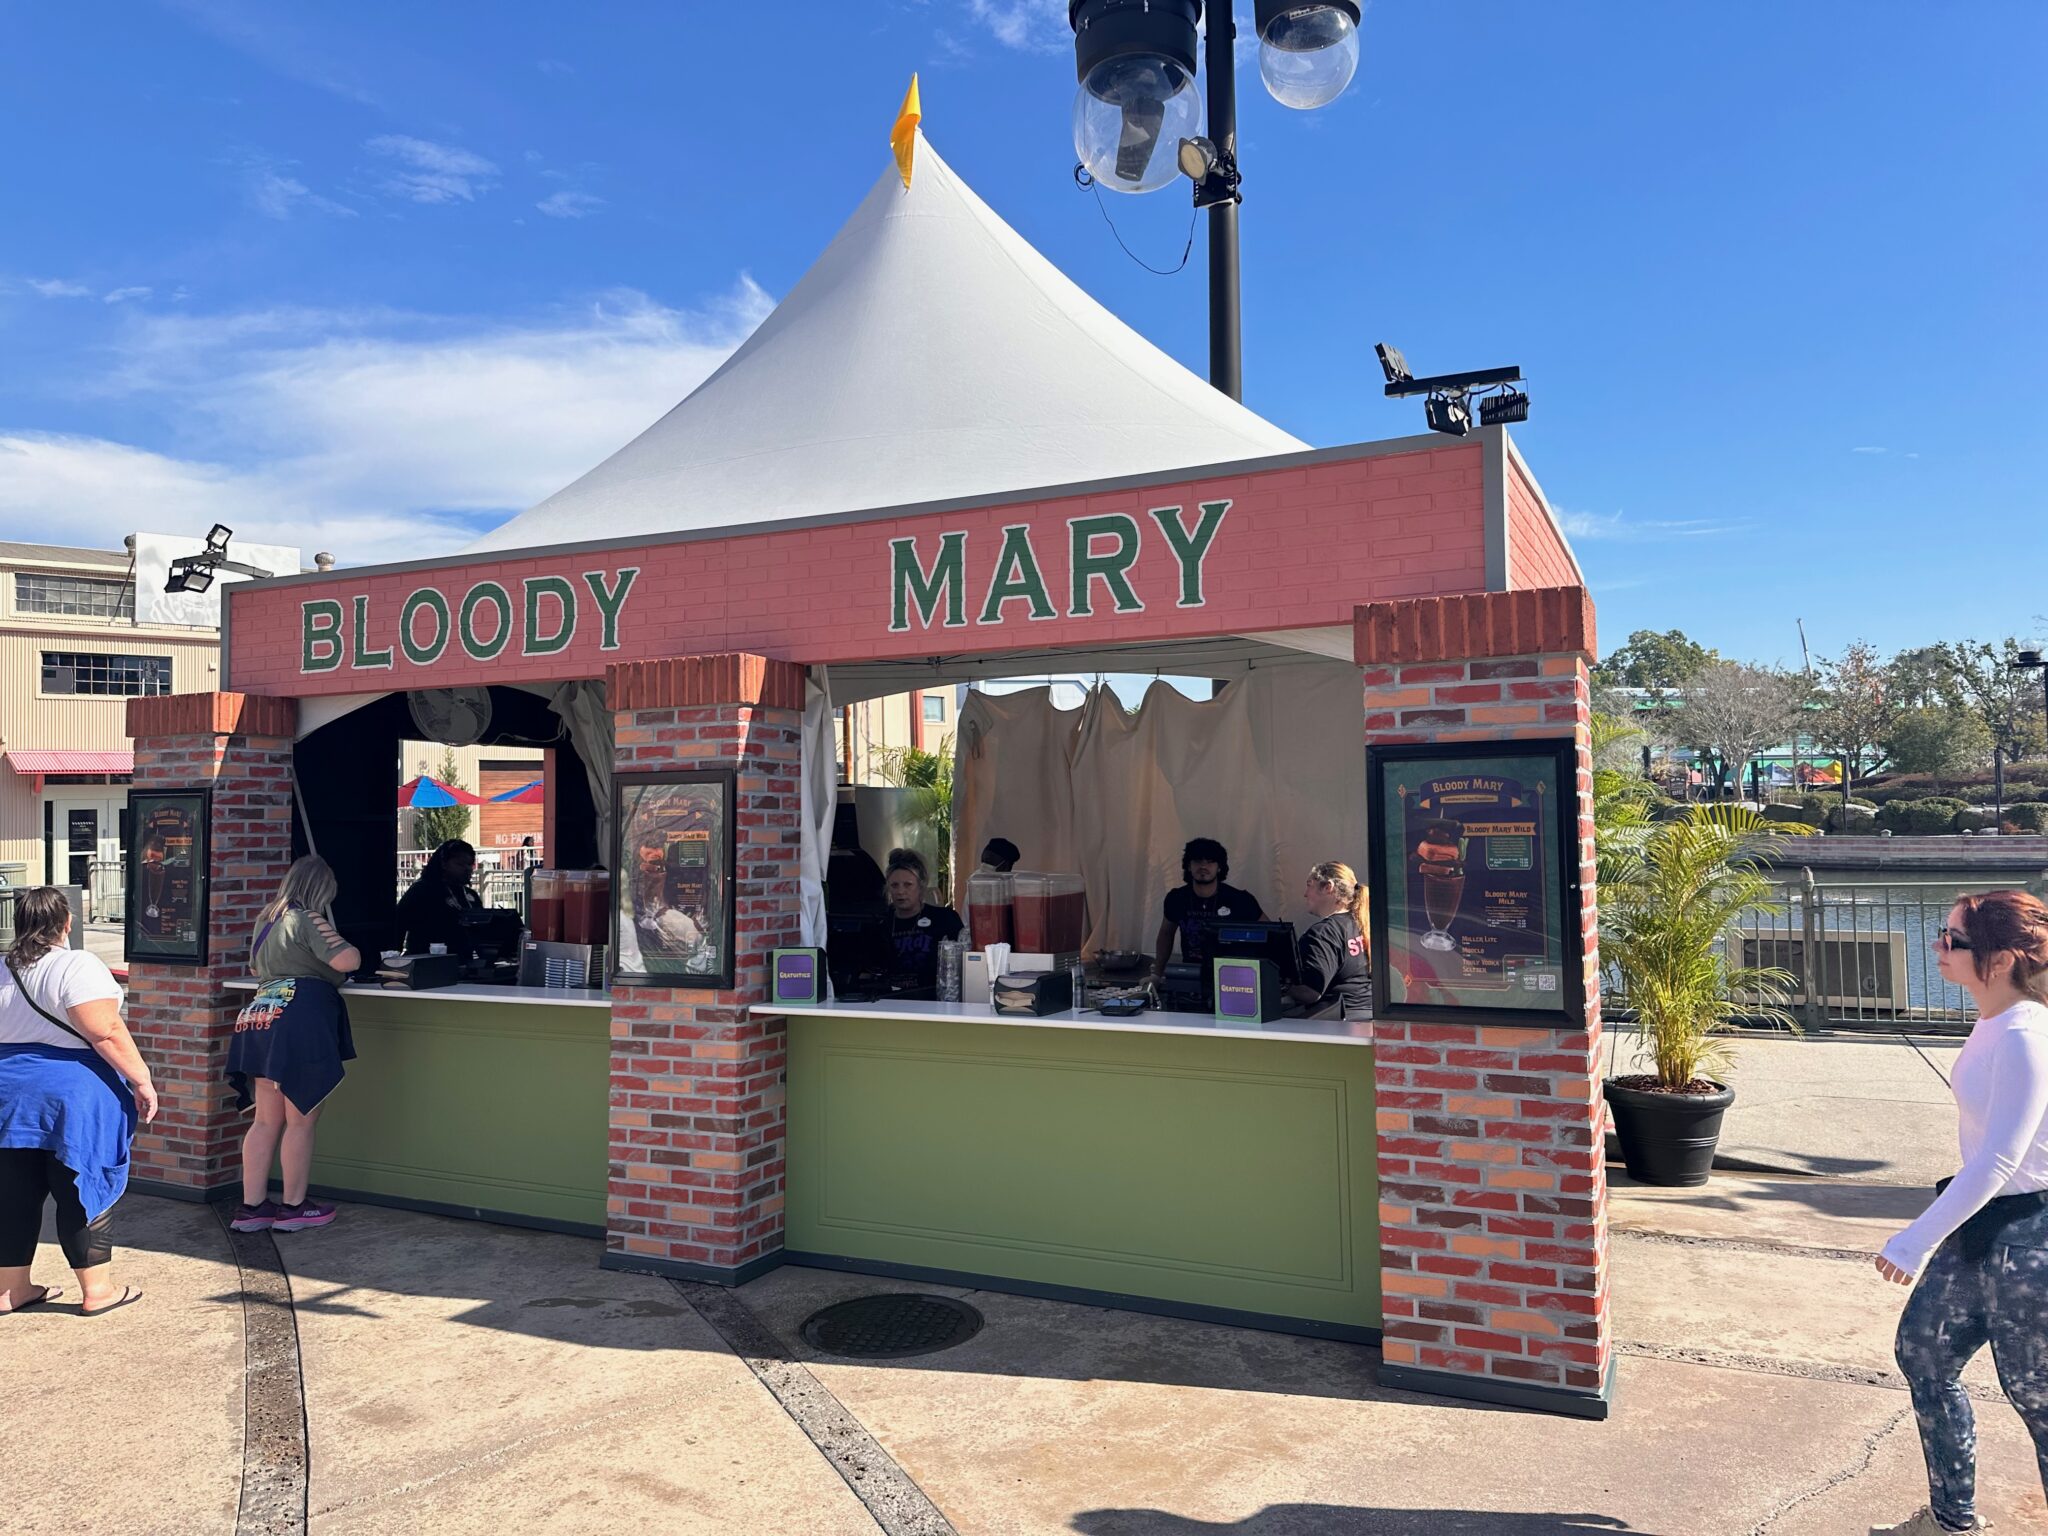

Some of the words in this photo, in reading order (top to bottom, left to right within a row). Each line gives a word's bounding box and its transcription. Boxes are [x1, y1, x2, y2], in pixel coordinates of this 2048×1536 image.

[300, 567, 640, 673] BLOODY
[888, 499, 1233, 632] MARY
[1472, 778, 1504, 792] MARY
[495, 833, 508, 845] NO
